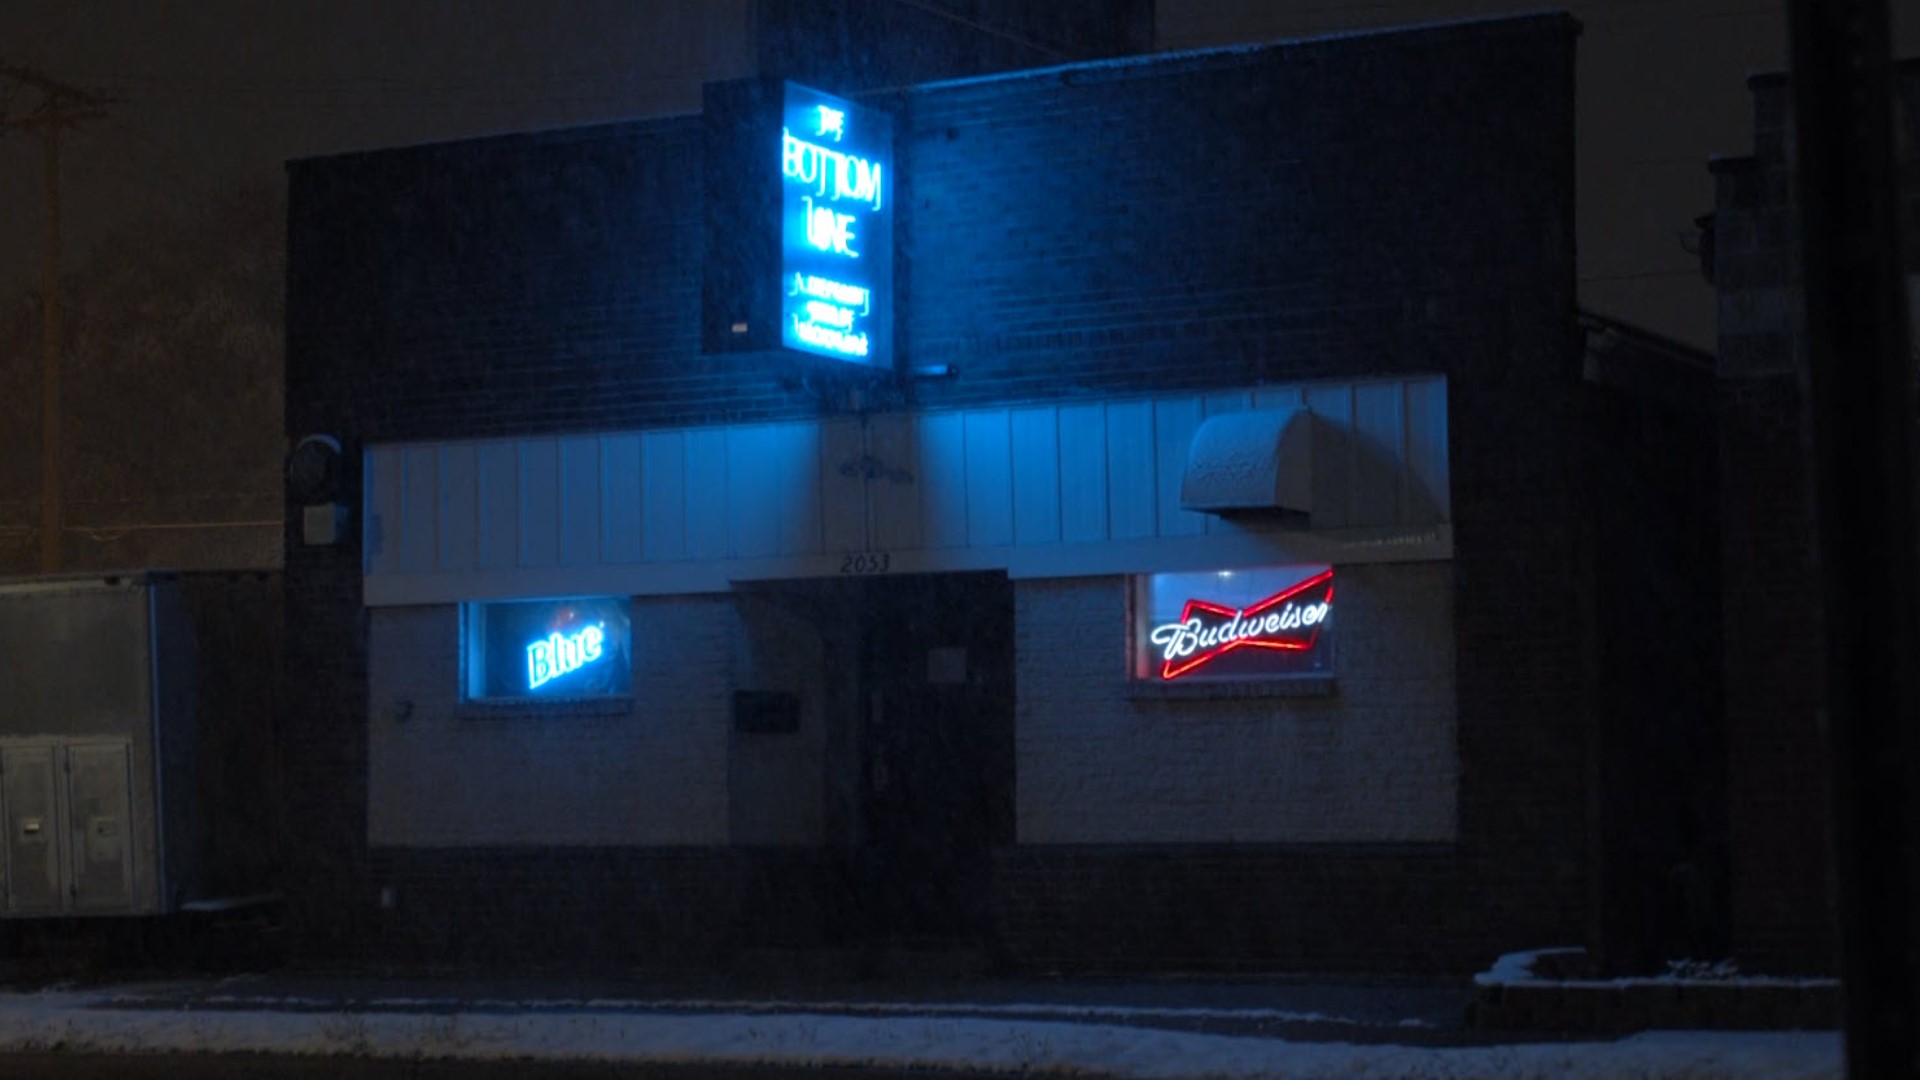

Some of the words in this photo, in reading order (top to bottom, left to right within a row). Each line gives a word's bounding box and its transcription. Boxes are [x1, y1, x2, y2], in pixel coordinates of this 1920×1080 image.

[782, 126, 882, 211] BOTTOM
[801, 196, 860, 258] LINE
[840, 553, 891, 574] 2053
[526, 624, 605, 690] Blue
[1151, 601, 1330, 660] Budweiser
